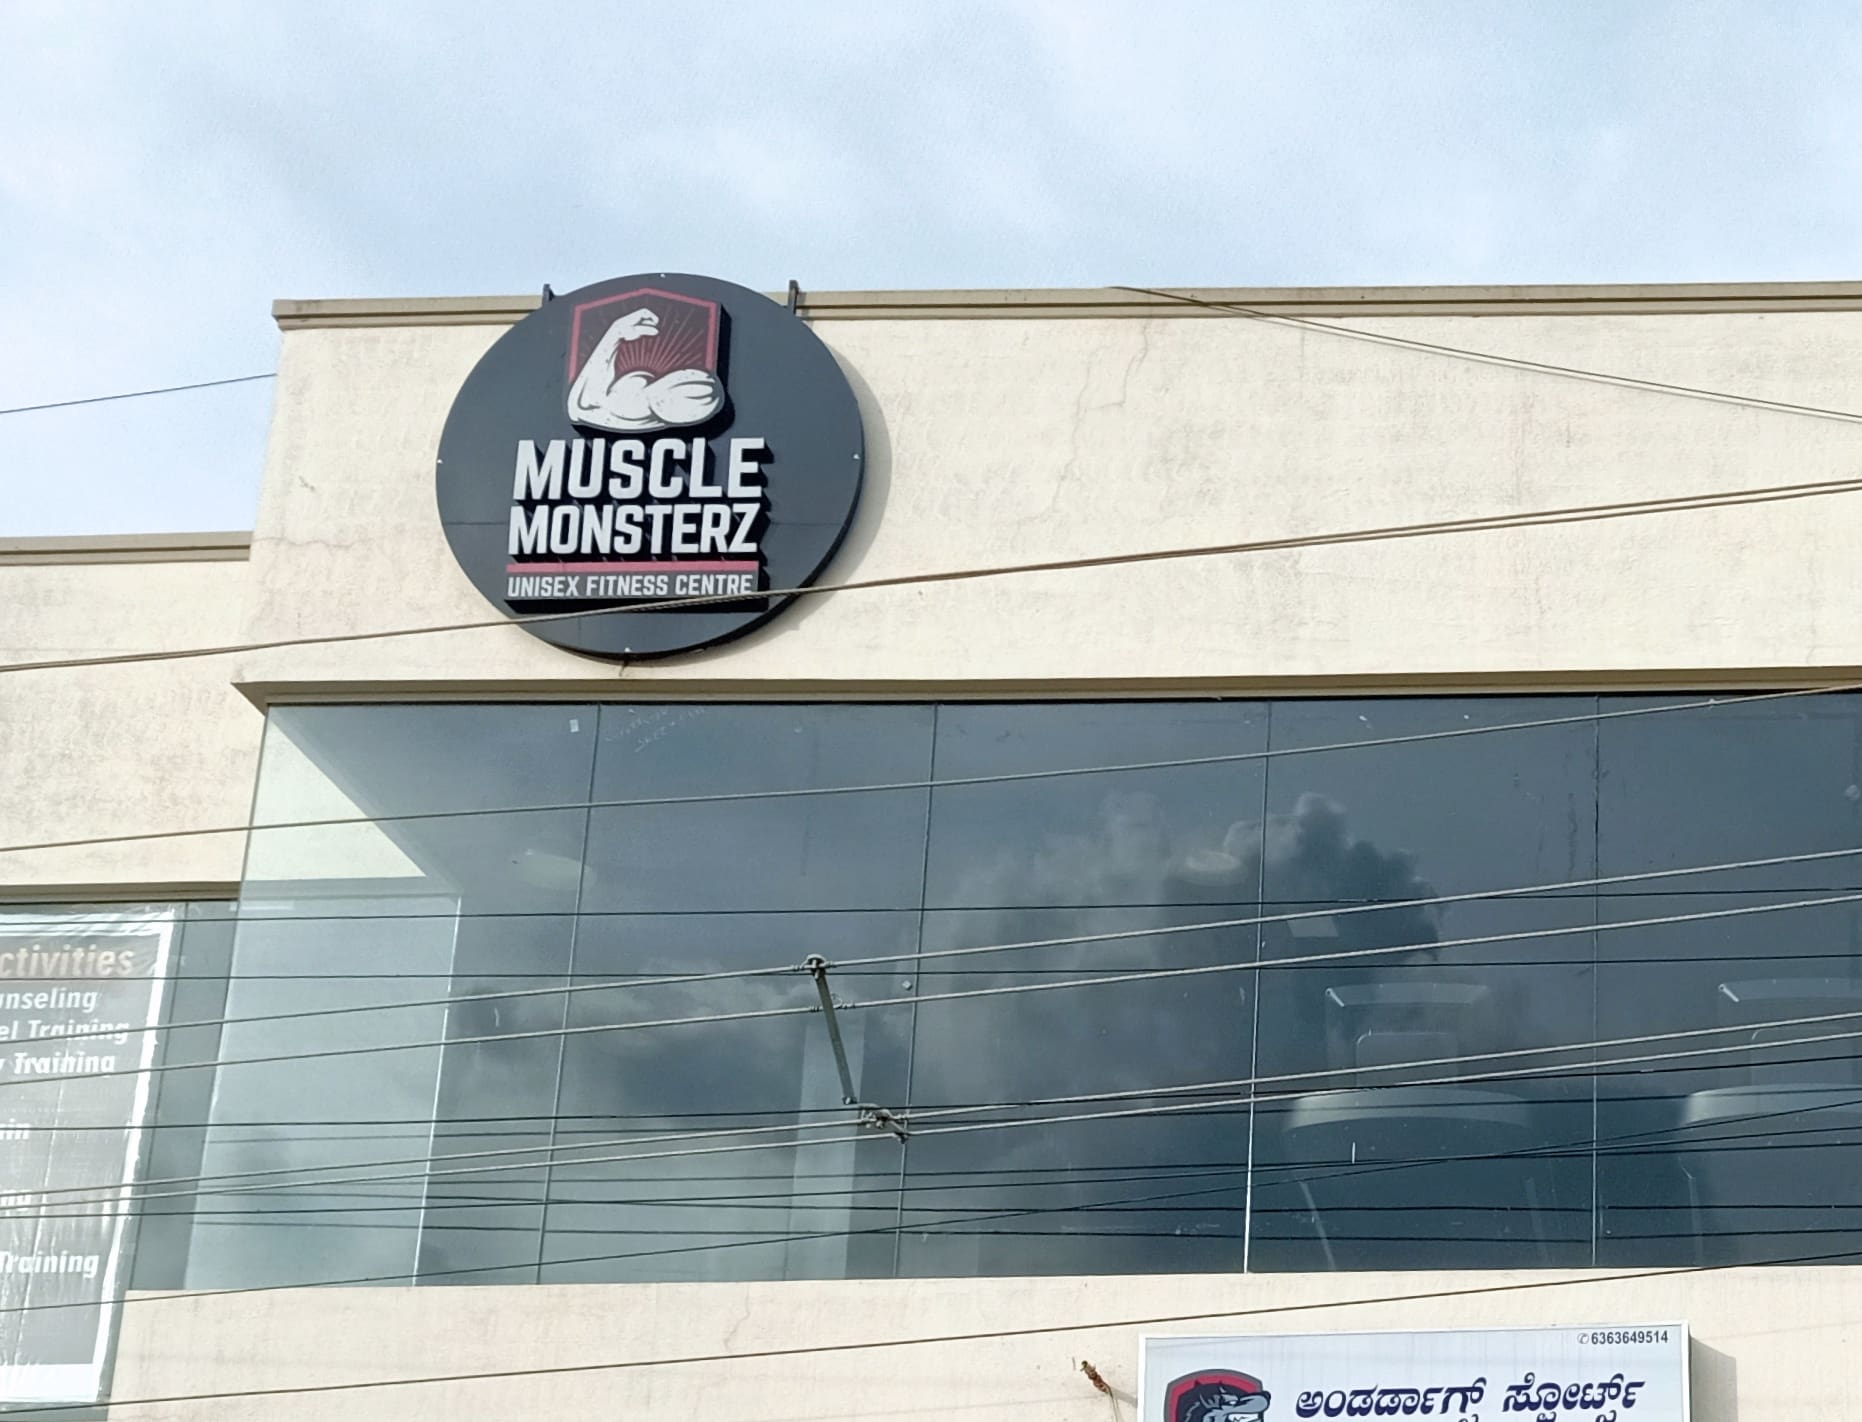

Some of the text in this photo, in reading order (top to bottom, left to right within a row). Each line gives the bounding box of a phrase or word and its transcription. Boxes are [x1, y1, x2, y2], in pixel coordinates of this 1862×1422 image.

[513, 437, 766, 500] MUSCLE
[508, 503, 760, 555] MONSTERZ
[508, 574, 753, 597] UNISEX FITNESS CENTRE
[28, 1018, 130, 1045] Training
[14, 1050, 116, 1078] Training
[1590, 1330, 1669, 1345] 6363649514
